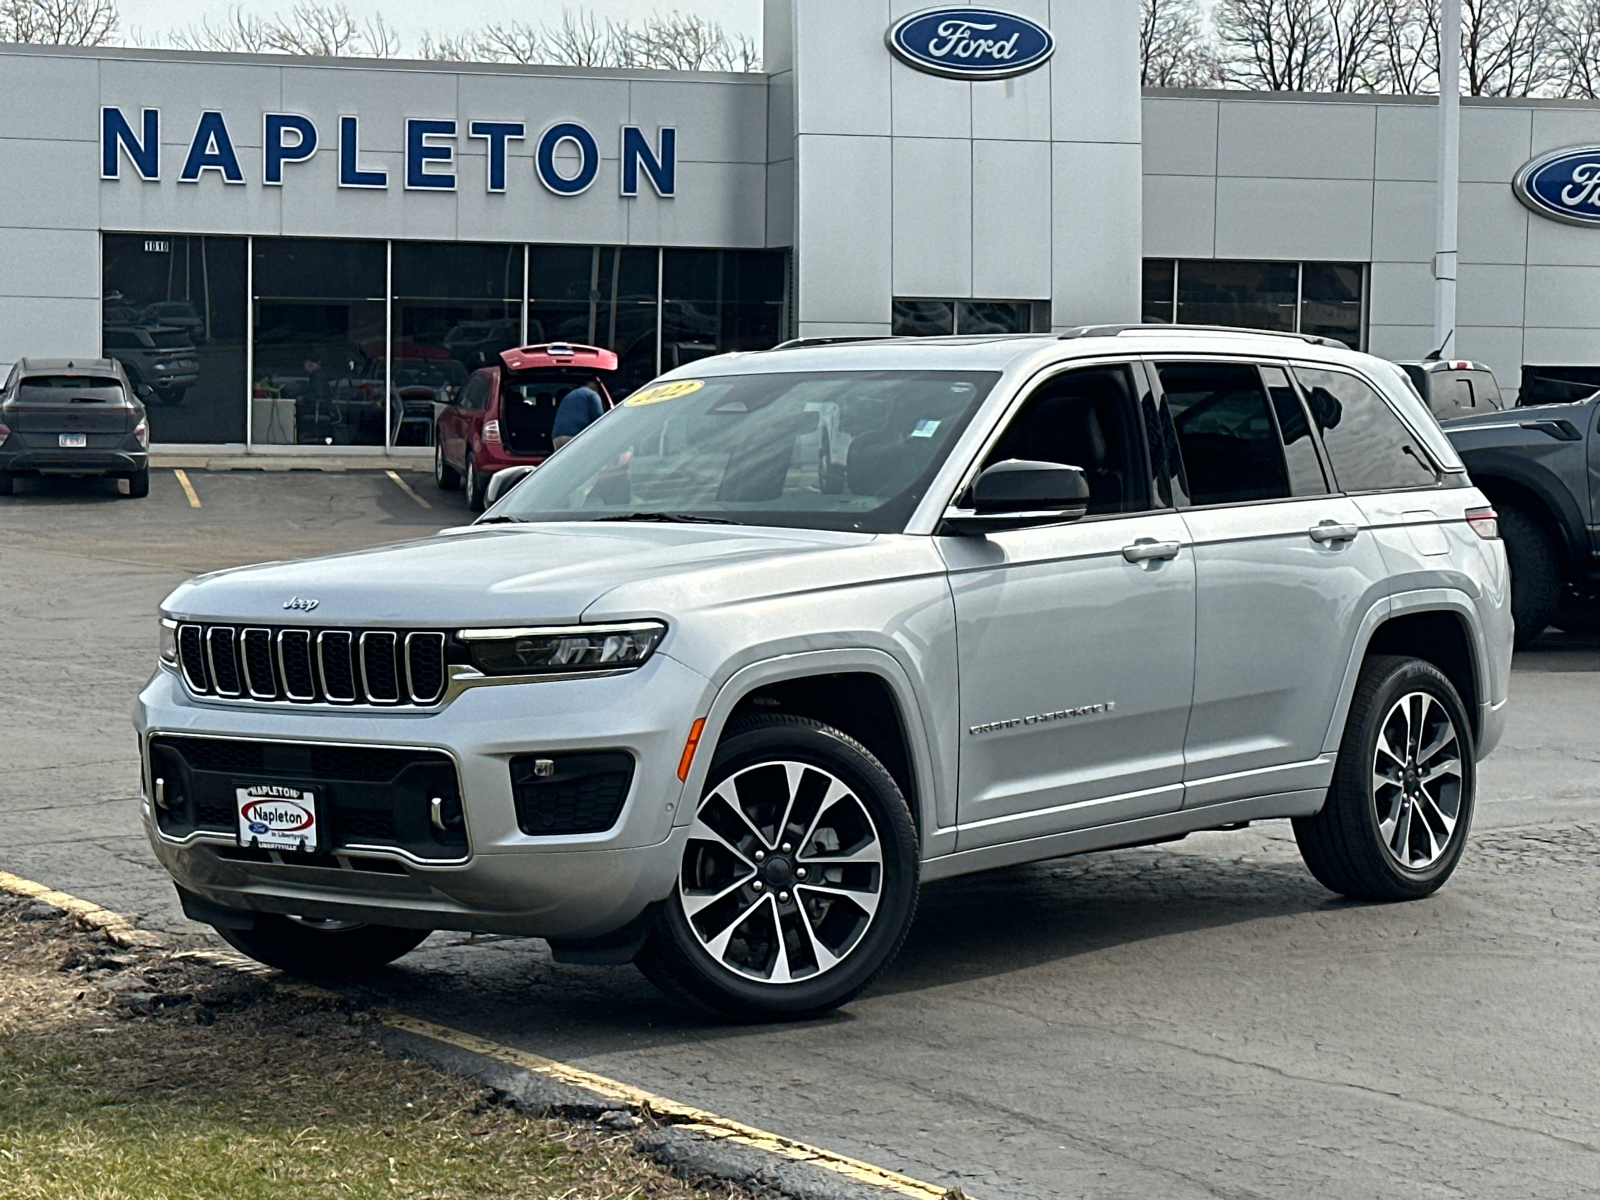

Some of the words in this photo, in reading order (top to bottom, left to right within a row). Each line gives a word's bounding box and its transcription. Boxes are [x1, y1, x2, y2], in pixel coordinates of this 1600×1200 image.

[928, 20, 1020, 59] Ford
[100, 105, 677, 198] NAPLETON
[1561, 163, 1600, 207] Fo
[145, 240, 169, 252] 1010
[282, 595, 320, 613] Jeep
[969, 718, 1021, 736] GRAND
[1024, 703, 1103, 726] CHEROKEE
[249, 786, 300, 798] NAPLETON
[253, 805, 303, 826] Napleton
